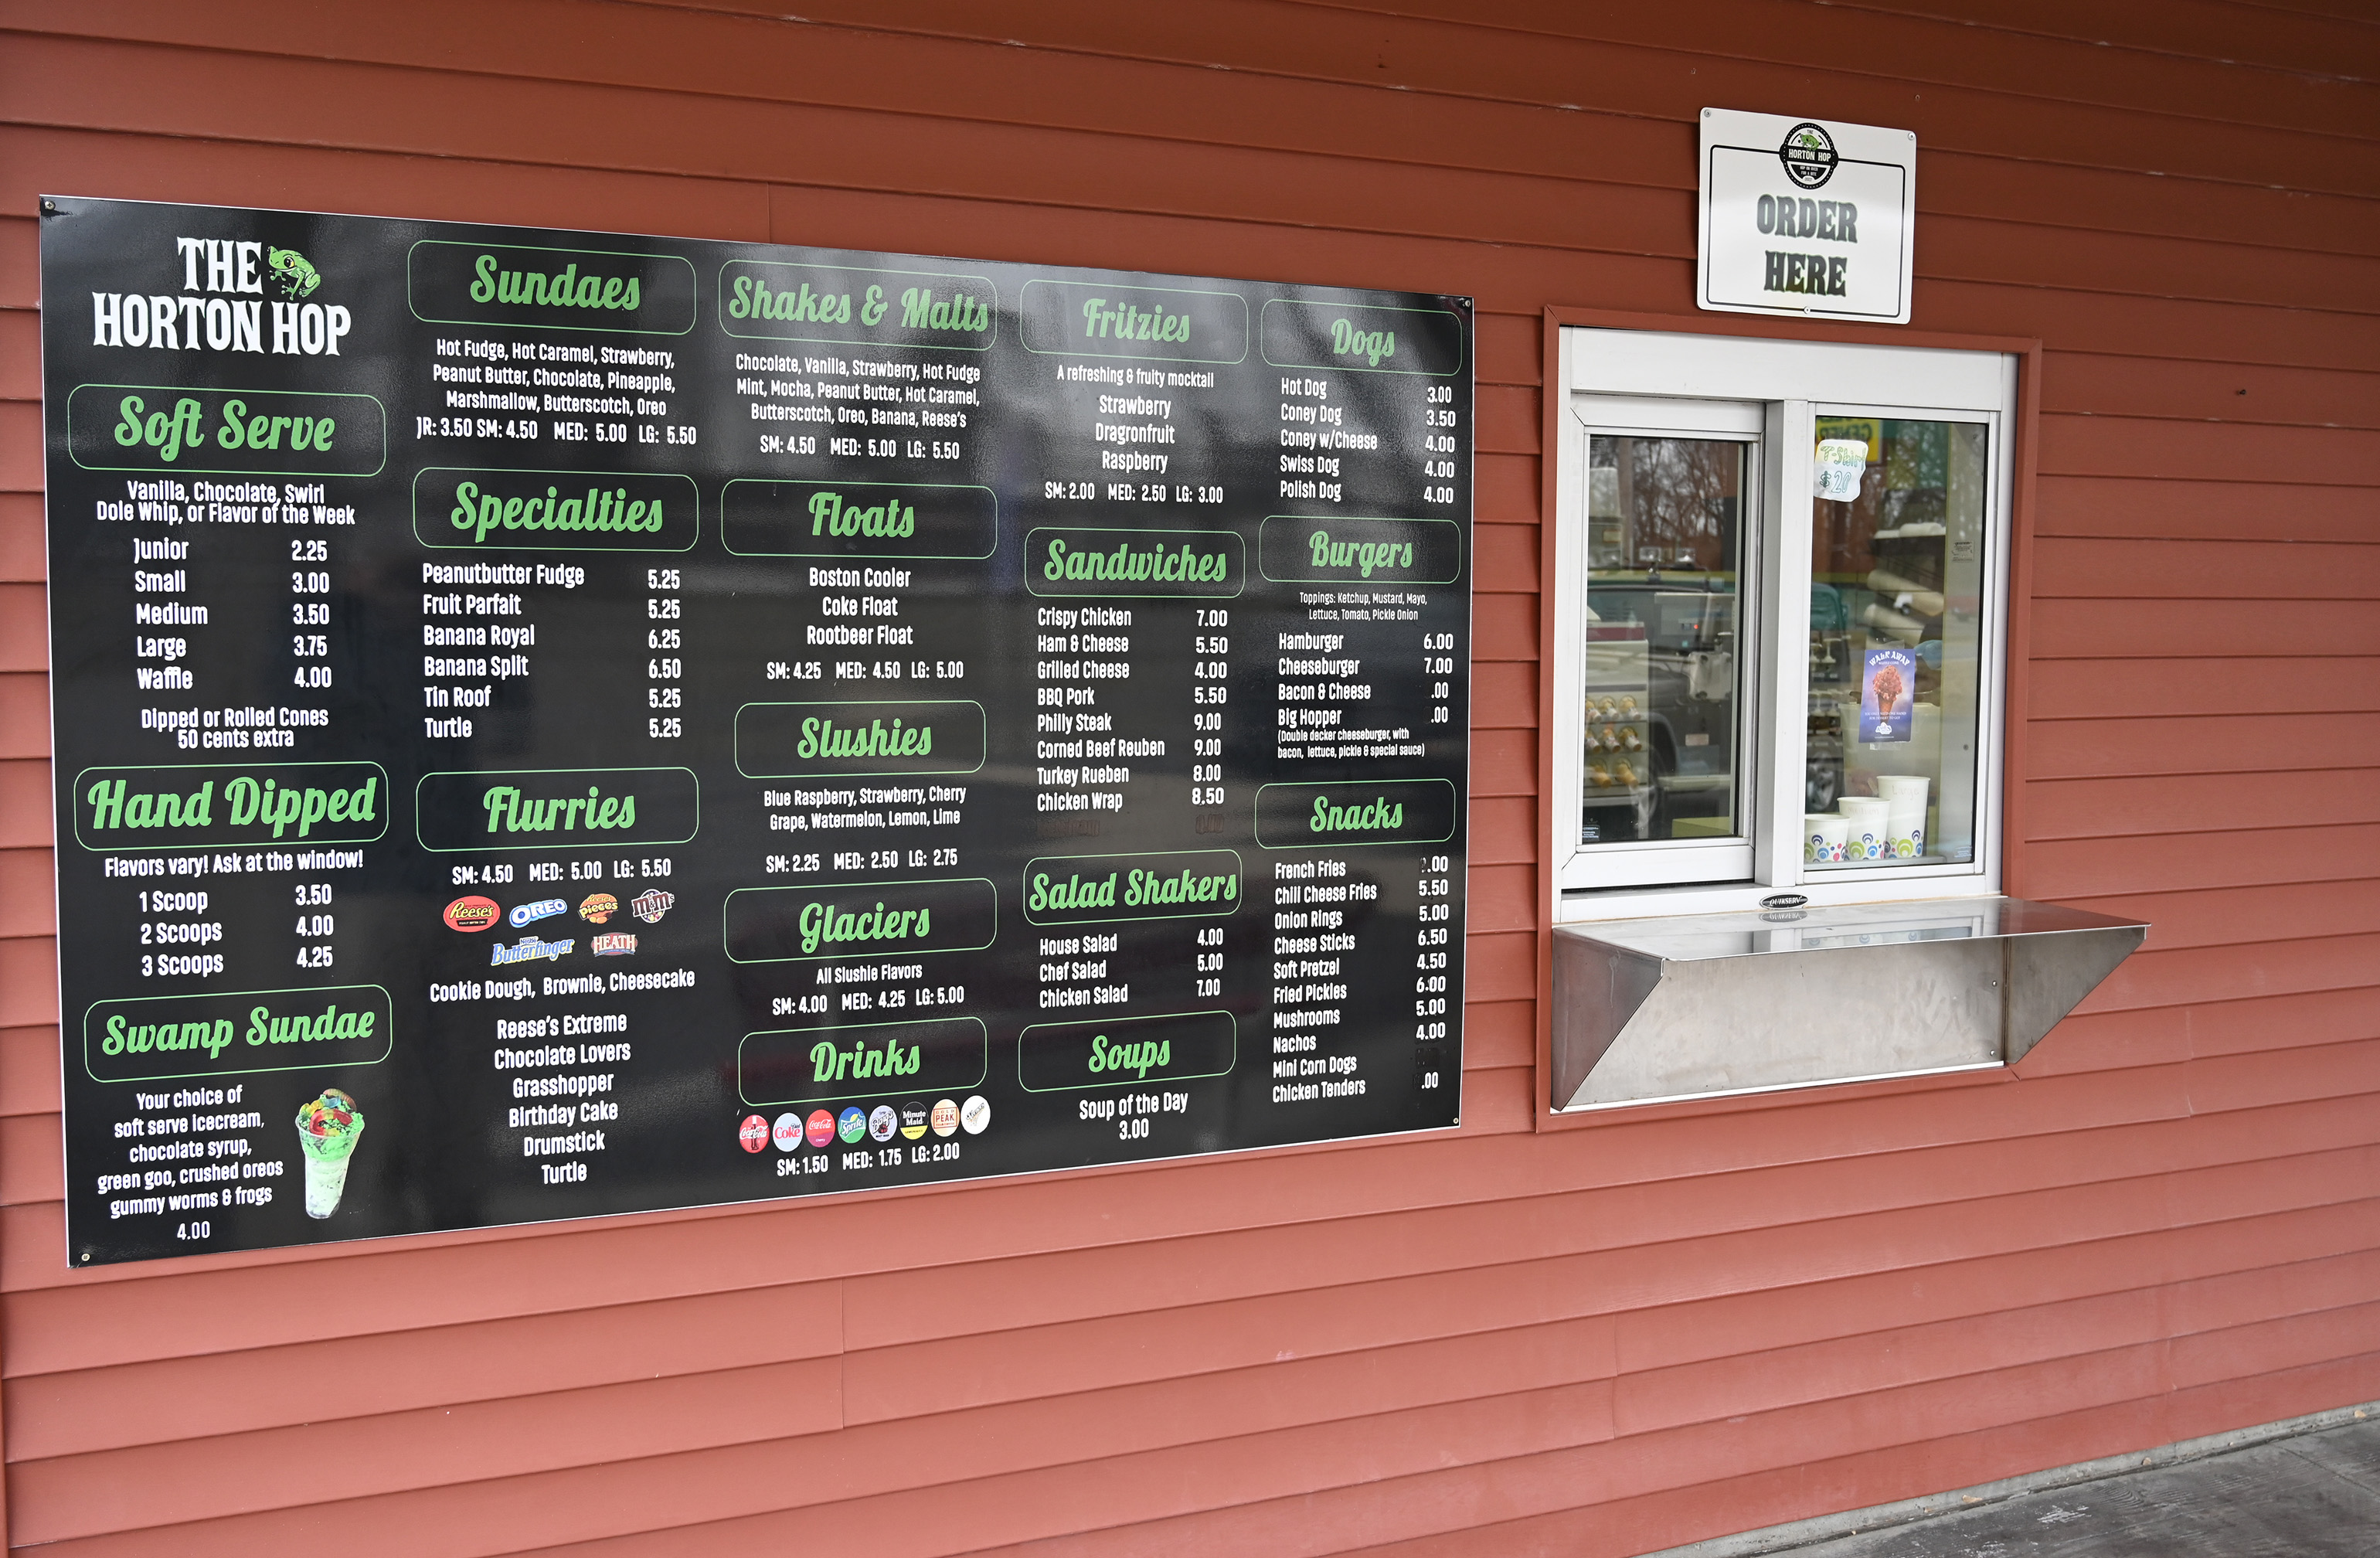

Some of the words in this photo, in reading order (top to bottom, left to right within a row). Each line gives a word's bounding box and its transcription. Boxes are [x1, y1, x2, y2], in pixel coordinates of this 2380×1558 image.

[1788, 148, 1815, 161] HORTON
[1817, 152, 1831, 162] HOP
[1756, 194, 1858, 243] ORDER
[177, 236, 264, 294] THE
[1763, 250, 1848, 297] HERE
[471, 255, 639, 308] Sundaes
[729, 276, 851, 325] Shakes
[861, 284, 888, 325] &
[901, 287, 989, 333] Malts
[92, 291, 264, 354] HORTON
[272, 304, 351, 355] HOP
[1083, 298, 1189, 343] Fritzies
[1331, 318, 1395, 367] Dogs
[1057, 365, 1064, 380] A
[1067, 365, 1124, 386] refreshing
[1127, 368, 1134, 383] &
[1136, 368, 1165, 389] fruity
[1168, 371, 1214, 388] mocktail
[1281, 377, 1302, 395] Hot
[1305, 379, 1327, 400] Dog
[1427, 386, 1452, 403] 3.00
[447, 390, 540, 413] Marshmallow,
[544, 394, 634, 417] Butterscotch,
[638, 398, 666, 416] Oreo
[751, 403, 835, 424] Butterscotch,
[838, 407, 868, 426] Oreo,
[872, 408, 919, 428] Banana,
[923, 410, 967, 427] Reese's
[114, 396, 205, 461] Soft
[218, 400, 334, 451] Serve
[1096, 423, 1175, 444] Dragronfruit
[1280, 429, 1316, 450] Coney
[1319, 429, 1378, 450] w/Cheese
[1425, 435, 1455, 453] 4.00
[451, 482, 662, 543] Specialties
[809, 492, 913, 537] Floats
[134, 536, 189, 564] Junior
[291, 539, 327, 561] 2.25
[1045, 539, 1226, 582] Sandwiches
[1309, 531, 1412, 577] Burgers
[423, 563, 532, 584] Peanutbutter
[536, 563, 584, 589] Fudge
[648, 569, 680, 590] 5.25
[810, 567, 860, 587] Boston
[864, 567, 911, 587] Cooler
[1300, 592, 1335, 605] Toppings:
[1338, 592, 1370, 605] Ketchup,
[1372, 593, 1404, 605] Mustard,
[1406, 594, 1427, 606] Mayo,
[1038, 607, 1078, 629] Crispy
[1081, 607, 1131, 626] Chicken
[1196, 610, 1227, 627] 7.00
[1279, 632, 1344, 652] Hamburger
[1424, 633, 1454, 650] 6.00
[1868, 651, 1890, 666] WALK
[1891, 651, 1910, 666] AWAY
[178, 729, 199, 749] 50
[203, 729, 249, 748] cents
[253, 728, 294, 747] extra
[797, 717, 931, 758] Slushies
[1037, 740, 1082, 759] Corned
[1086, 737, 1117, 758] Beef
[1118, 737, 1165, 757] Reuben
[1194, 738, 1221, 756] 9.00
[1278, 747, 1304, 759] bacon,
[1307, 746, 1337, 758] lettuce,
[1338, 744, 1362, 759] pickle
[1363, 744, 1369, 757] &
[1370, 743, 1398, 759] special
[1399, 743, 1425, 757] sauce)
[1892, 784, 1920, 801] Large
[88, 780, 213, 829] Hand
[225, 777, 376, 838] Dipped
[484, 786, 635, 832] Flurries
[770, 814, 809, 833] Grape,
[811, 810, 886, 829] Watermelon,
[889, 811, 930, 827] Lemon,
[933, 808, 960, 825] Lime
[1311, 796, 1402, 832] Snacks
[139, 891, 148, 912] 1
[152, 890, 208, 914] Scoop
[295, 884, 332, 906] 3.50
[1029, 873, 1117, 911] Salad
[1124, 869, 1236, 906] Shakers
[1275, 886, 1300, 905] Chili
[1304, 885, 1346, 903] Cheese
[1349, 883, 1377, 900] Fries
[1419, 879, 1448, 896] 5.50
[450, 901, 495, 920] Reese's
[511, 900, 566, 925] OREO
[1275, 911, 1307, 930] Onion
[1311, 910, 1342, 929] Rings
[1420, 904, 1449, 921] 5.00
[800, 902, 930, 953] Glaciers
[491, 939, 575, 965] Butterfinger
[593, 934, 636, 954] HEATH
[1040, 938, 1080, 956] House
[1083, 933, 1117, 953] Salad
[1198, 928, 1223, 946] 4.00
[430, 980, 481, 1002] Cookie
[485, 977, 536, 1000] Dough,
[543, 973, 606, 995] Brownie,
[610, 968, 695, 992] Cheesecake
[772, 997, 796, 1015] SM:
[798, 995, 828, 1014] 4.00
[842, 992, 872, 1011] MED:
[878, 990, 905, 1008] 4.25
[916, 988, 933, 1005] LG:
[937, 985, 964, 1004] 5.00
[103, 1015, 233, 1060] Swamp
[246, 1005, 375, 1046] Sundae
[1273, 1034, 1316, 1053] Nachos
[1416, 1022, 1446, 1040] 4.00
[810, 1039, 920, 1082] Drinks
[1089, 1036, 1170, 1079] Soups
[513, 1073, 614, 1098] Grasshopper
[903, 1110, 926, 1119] Minute
[936, 1114, 955, 1122] PEAK
[1080, 1100, 1114, 1121] Soup
[1118, 1094, 1134, 1116] of
[1135, 1093, 1160, 1114] the
[1163, 1092, 1188, 1114] Day
[774, 1127, 801, 1139] Coke
[842, 1118, 863, 1135] Sprite
[906, 1117, 923, 1126] Maid
[1119, 1117, 1149, 1140] 3.00
[130, 1141, 204, 1163] chocolate
[208, 1138, 252, 1158] syrup,
[524, 1130, 605, 1157] Drumstick
